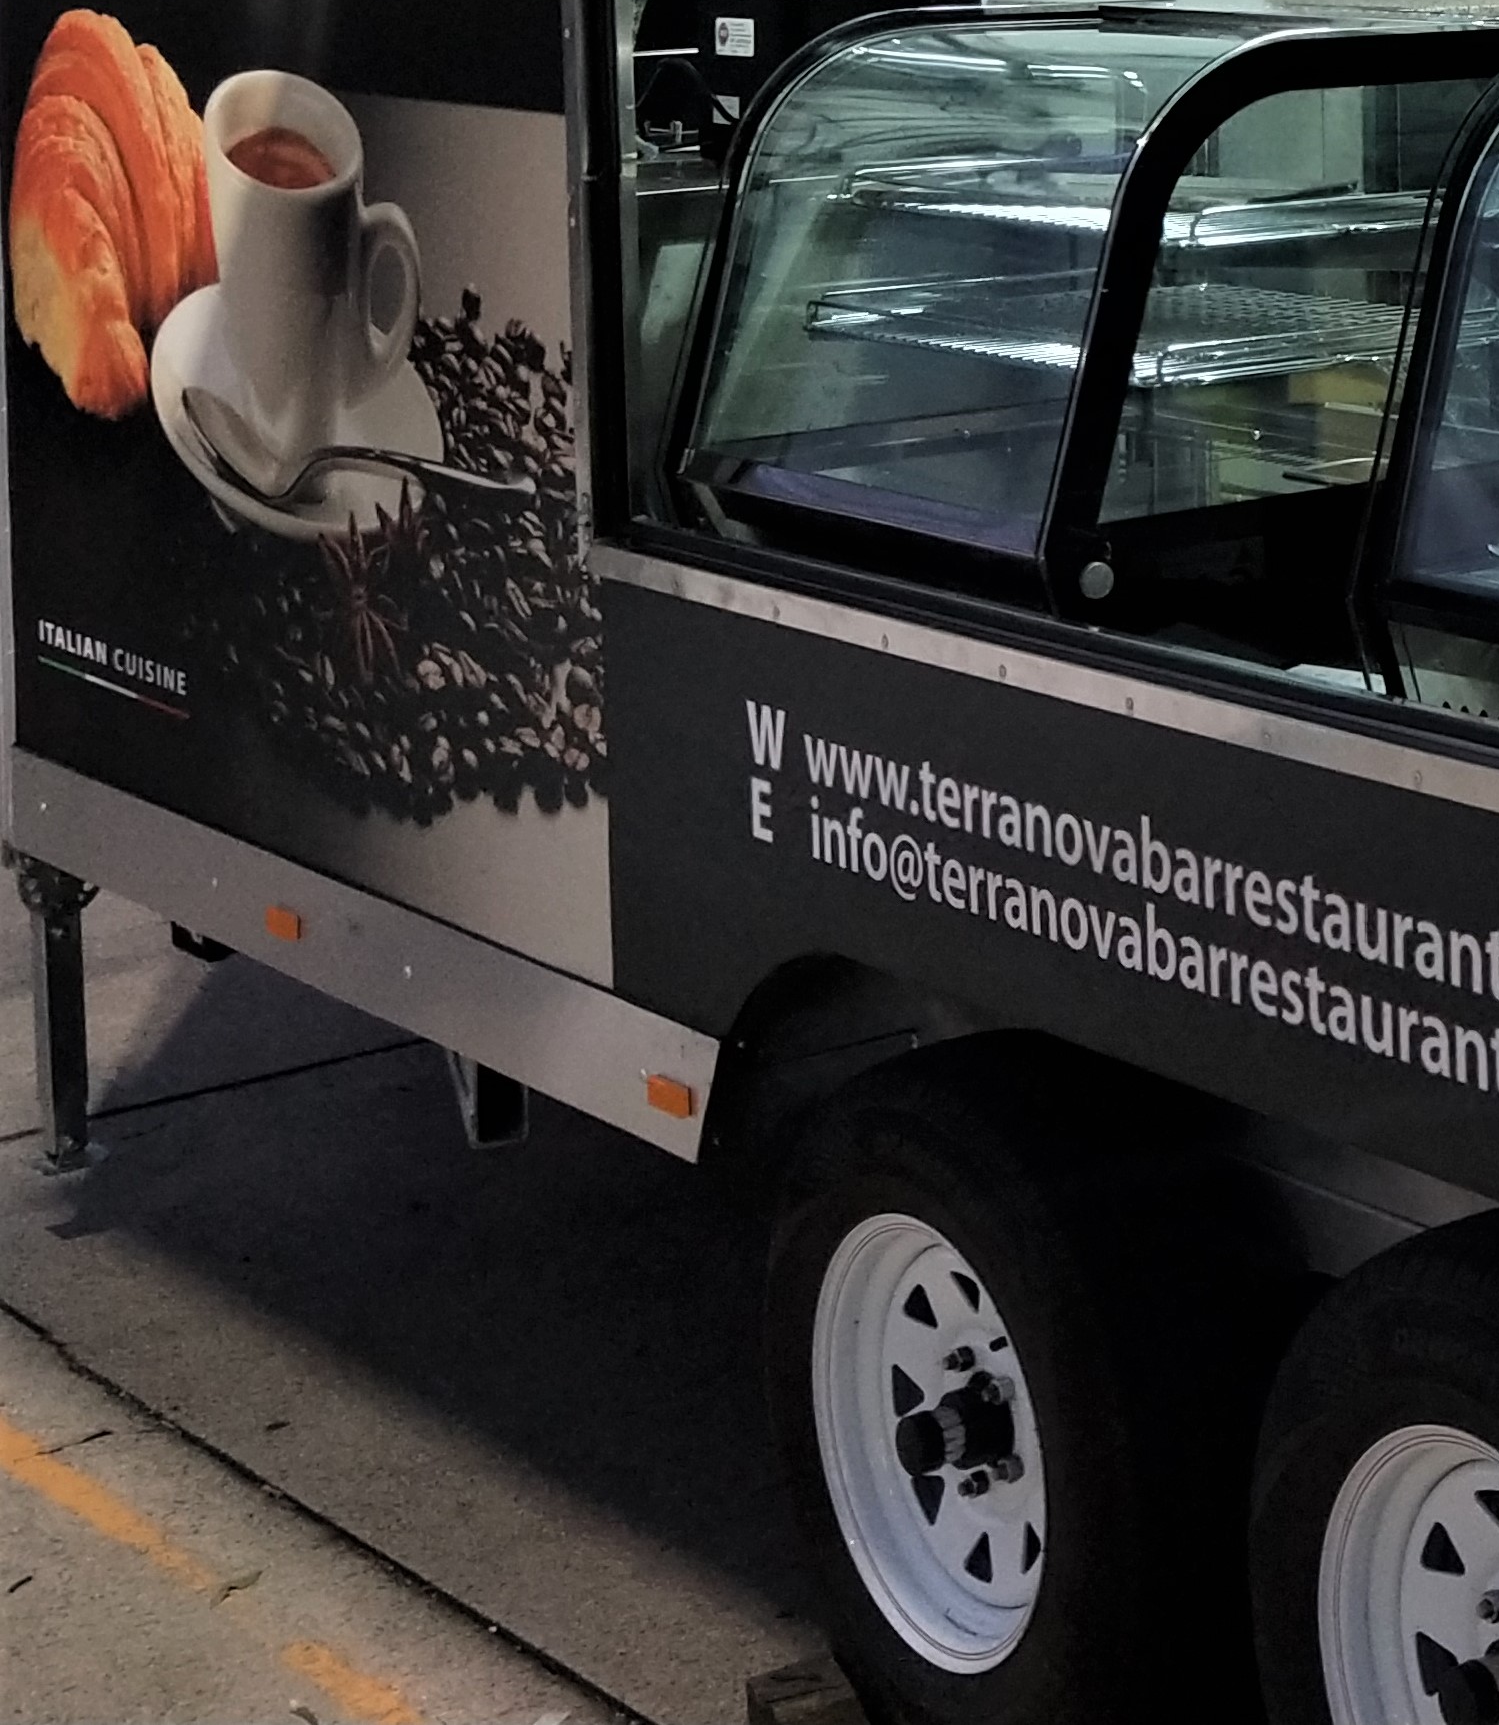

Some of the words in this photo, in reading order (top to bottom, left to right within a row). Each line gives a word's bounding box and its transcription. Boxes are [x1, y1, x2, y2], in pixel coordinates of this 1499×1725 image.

[38, 619, 108, 666] ITALIAN
[112, 648, 188, 696] CUISINE
[746, 699, 786, 771] W
[750, 776, 774, 843] E
